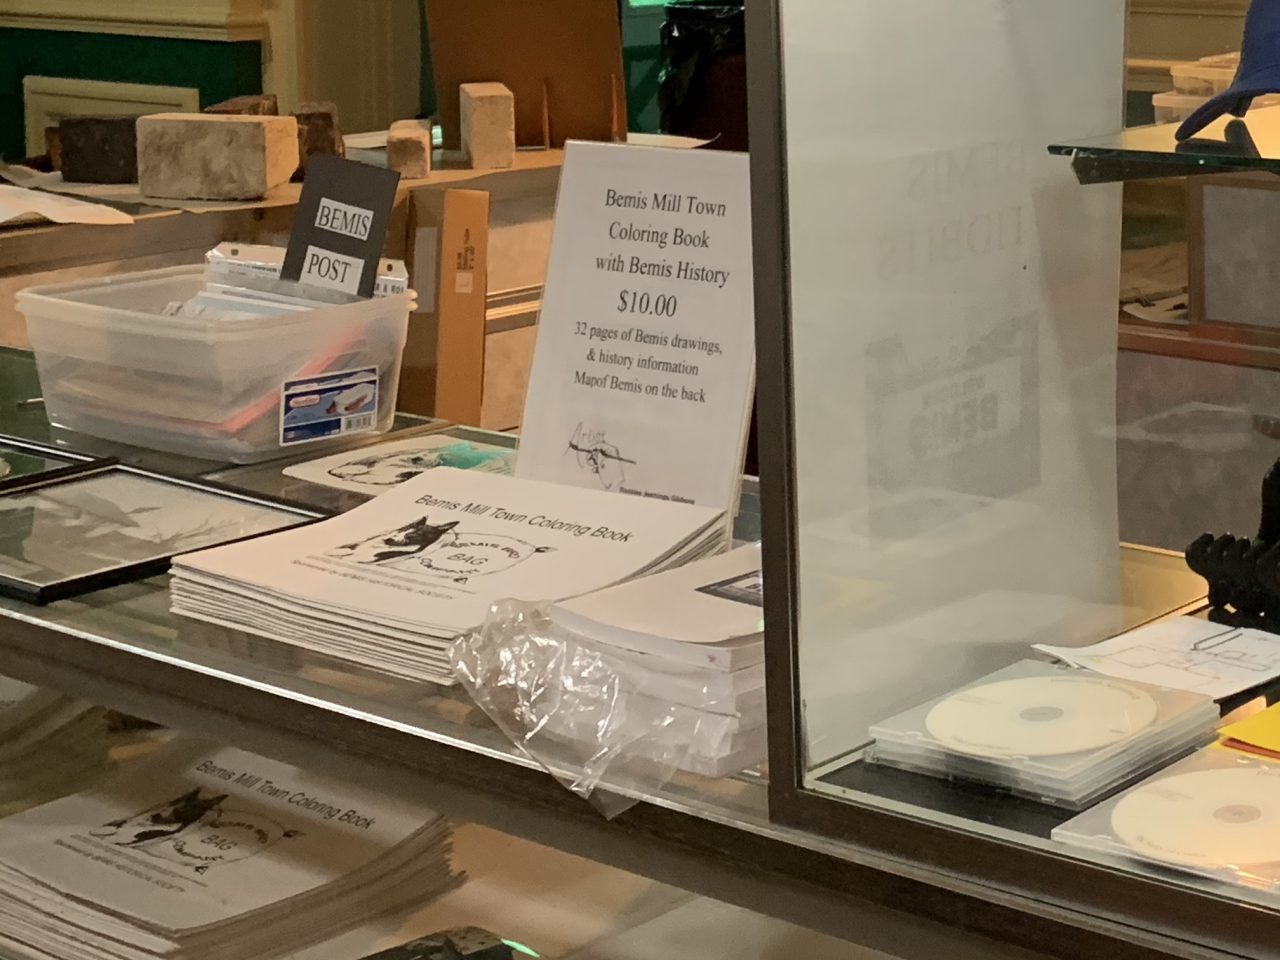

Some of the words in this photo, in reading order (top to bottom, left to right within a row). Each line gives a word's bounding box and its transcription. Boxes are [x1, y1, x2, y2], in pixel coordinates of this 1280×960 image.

[605, 189, 648, 210] Bemis
[651, 193, 682, 213] Mill
[686, 196, 727, 217] Town
[318, 205, 370, 237] BEMIS
[609, 221, 669, 249] Coloring
[672, 227, 711, 249] Book
[307, 253, 352, 283] POST
[596, 253, 625, 273] with
[629, 256, 673, 278] Bemis
[676, 261, 731, 289] History
[617, 289, 678, 318] $10.00
[574, 321, 588, 336] 32
[590, 326, 619, 342] pages
[621, 327, 634, 342] of
[635, 329, 668, 346] Bemis
[671, 333, 723, 356] drawings,
[586, 347, 597, 362] &
[599, 349, 634, 370] history
[637, 354, 699, 376] information
[610, 375, 643, 394] Bemis
[645, 384, 659, 396] on
[661, 383, 678, 399] the
[681, 386, 706, 403] back
[415, 494, 461, 511] Bemis
[459, 502, 493, 514] Mill
[488, 508, 529, 524] Town
[528, 515, 589, 536] Coloring
[590, 526, 634, 543] Book
[195, 760, 236, 781] Bemis
[234, 772, 262, 789] Mill
[258, 780, 290, 799] Town
[287, 792, 341, 820] Coloring
[338, 809, 376, 830] Book
